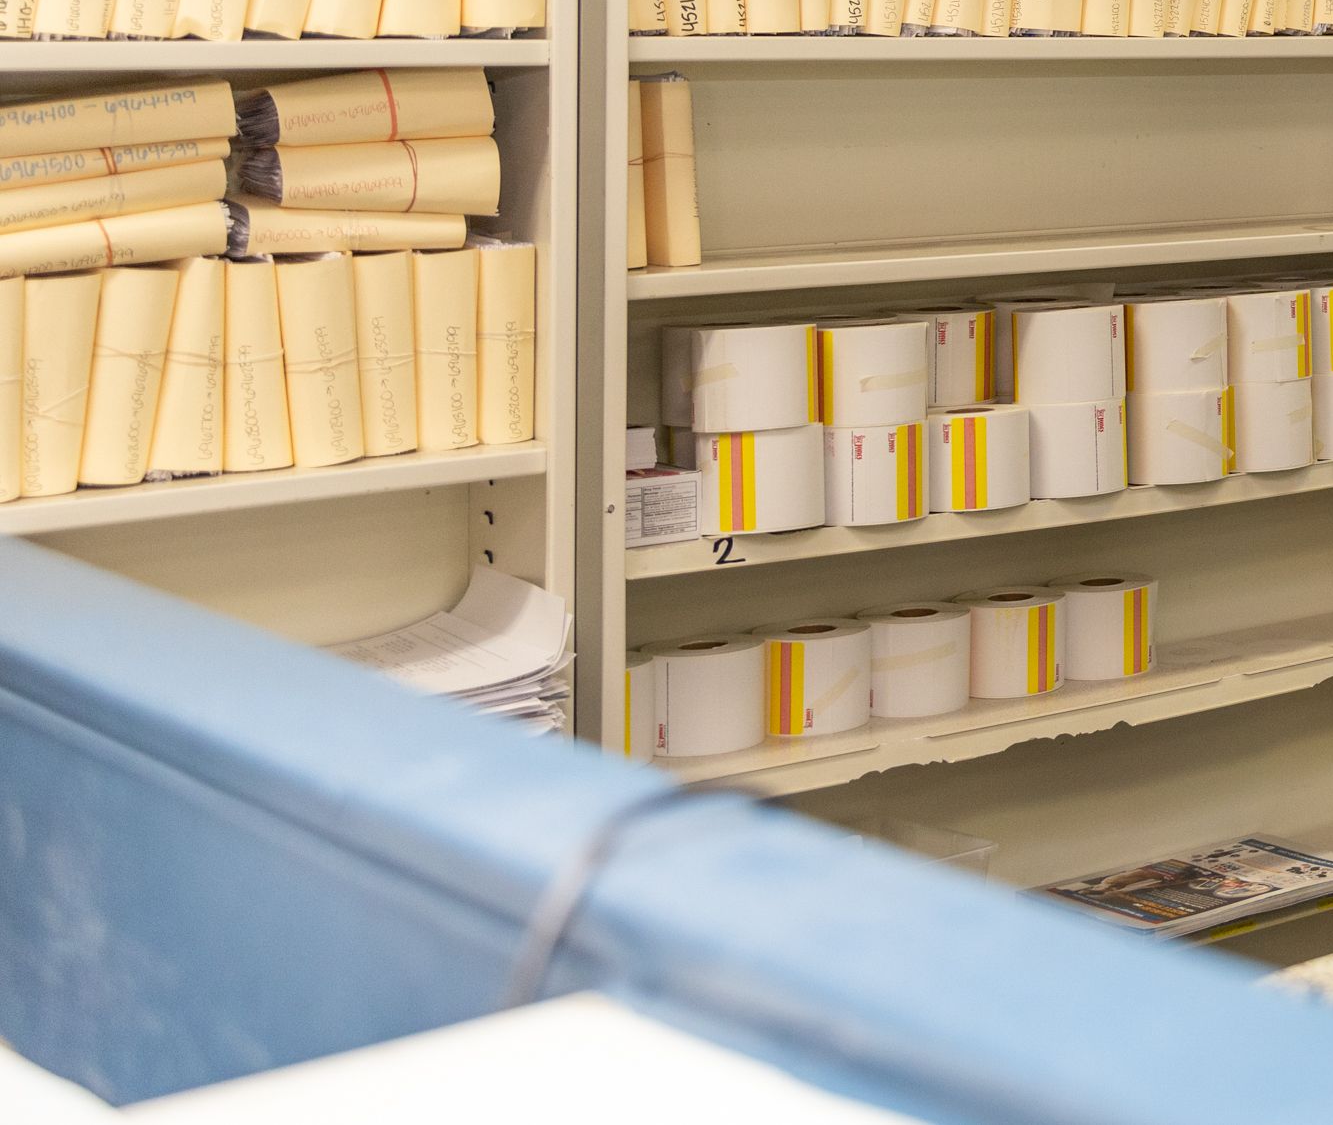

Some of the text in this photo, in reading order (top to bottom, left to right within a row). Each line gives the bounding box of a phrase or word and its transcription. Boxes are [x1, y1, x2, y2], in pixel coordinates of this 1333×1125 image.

[104, 90, 197, 113] 6964499
[446, 325, 462, 377] 6963199
[712, 537, 747, 566] 2
